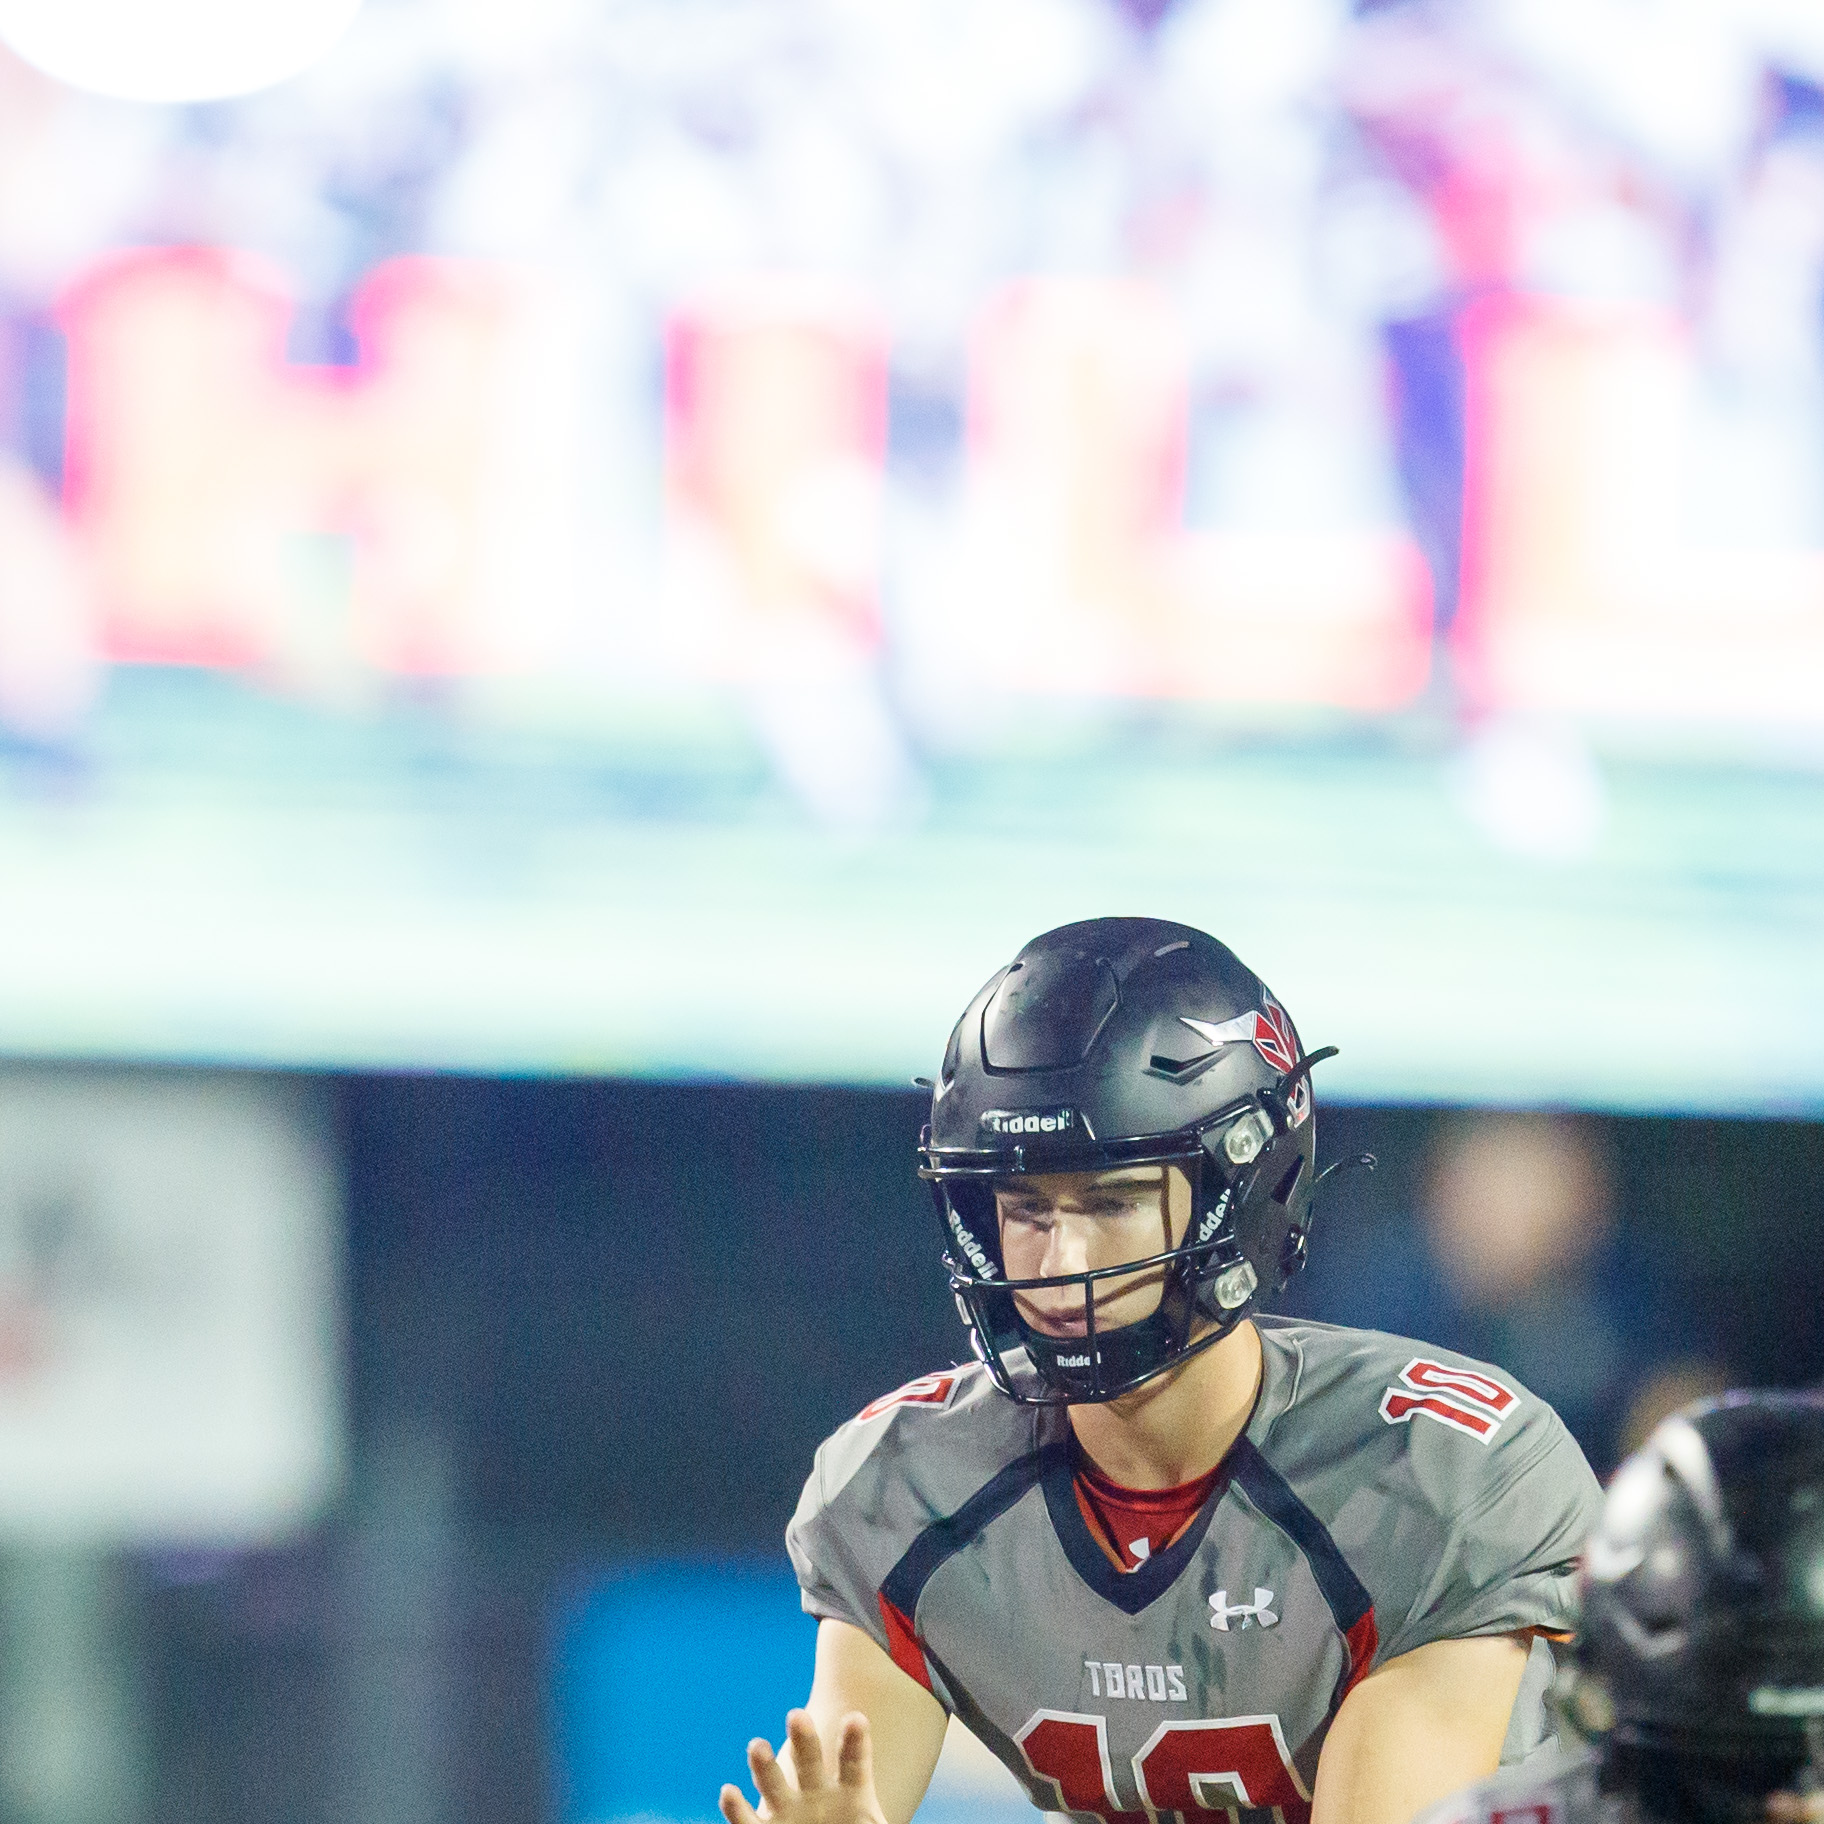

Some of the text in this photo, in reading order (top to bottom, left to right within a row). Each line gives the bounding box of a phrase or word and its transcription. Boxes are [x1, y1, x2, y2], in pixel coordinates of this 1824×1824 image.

[856, 1364, 966, 1426] 0
[1378, 1357, 1522, 1446] 10
[1084, 1660, 1188, 1701] TOROS
